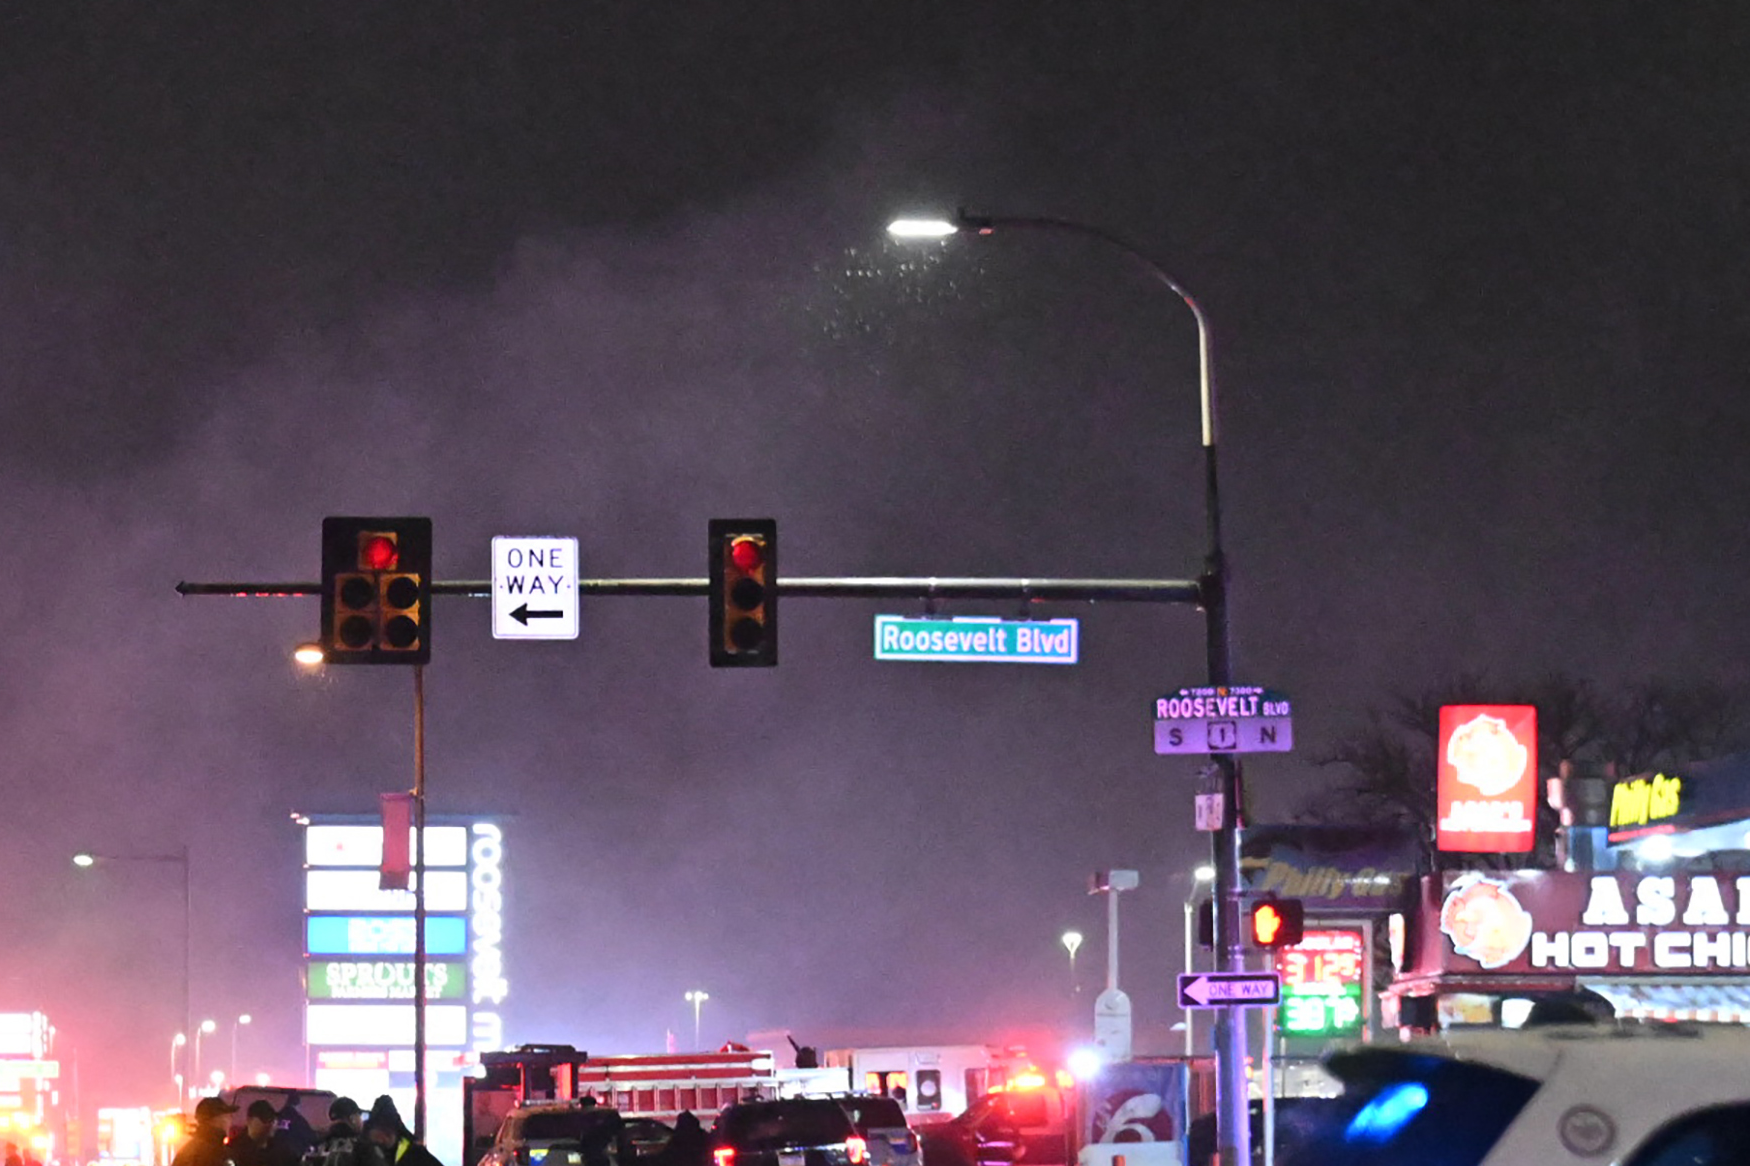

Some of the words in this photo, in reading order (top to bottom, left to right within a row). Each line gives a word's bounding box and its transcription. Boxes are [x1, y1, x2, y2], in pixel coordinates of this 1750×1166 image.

[507, 547, 564, 568] ONE
[506, 575, 564, 594] WAY
[883, 625, 1007, 652] Roosevelt
[1016, 628, 1069, 653] Blvd
[1156, 696, 1258, 719] ROOSEVELT
[1168, 727, 1184, 747] S
[1259, 726, 1276, 744] N
[1531, 931, 1646, 968] HOT
[1654, 931, 1750, 968] CHI
[326, 962, 448, 987] SPROUS
[1209, 979, 1235, 996] ONE
[1241, 978, 1269, 995] WAY
